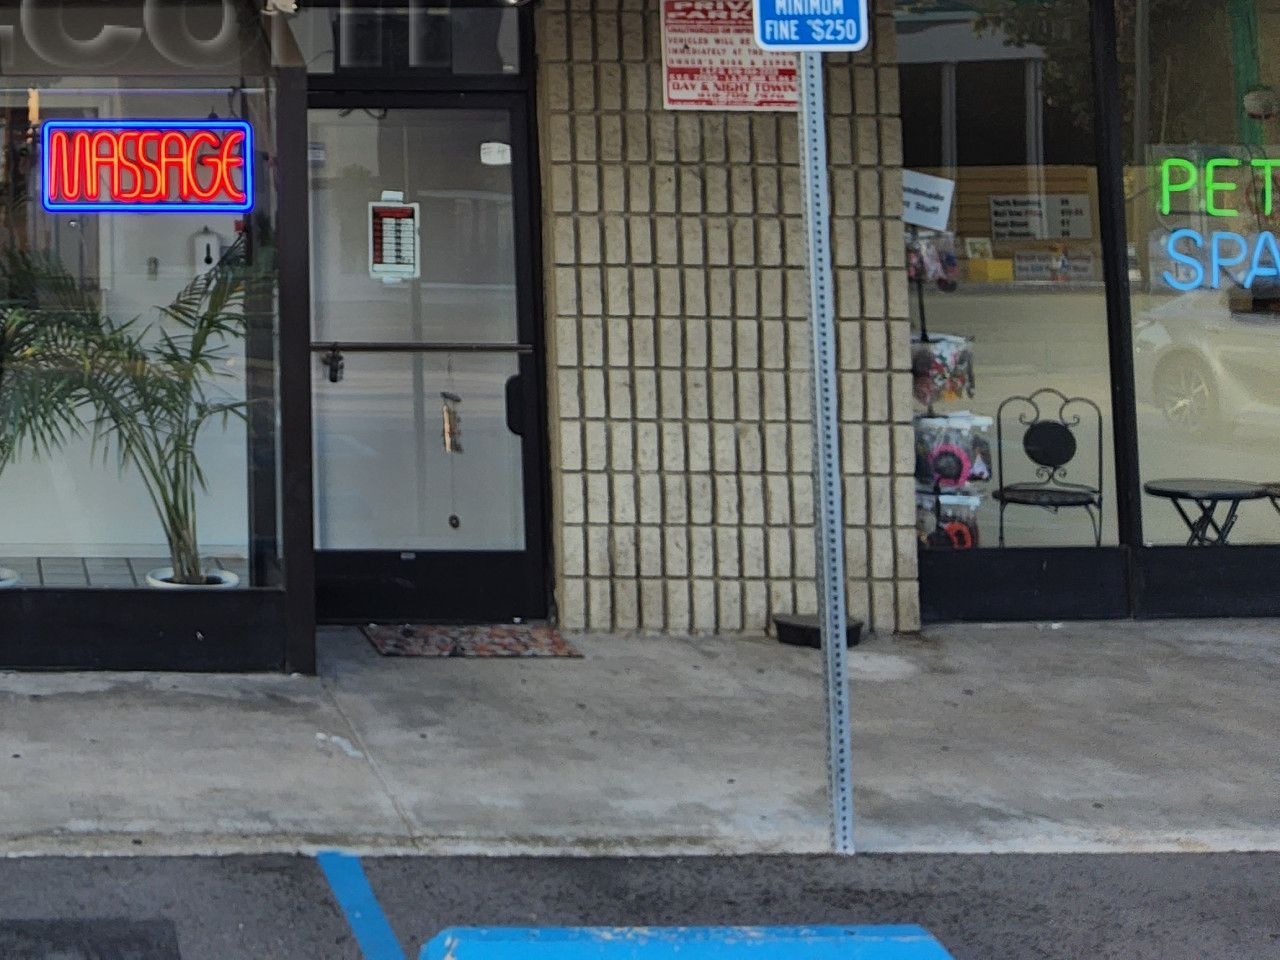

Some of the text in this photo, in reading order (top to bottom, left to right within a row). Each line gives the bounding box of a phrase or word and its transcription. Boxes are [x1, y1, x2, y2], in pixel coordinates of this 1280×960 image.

[667, 10, 752, 19] PARK
[673, 0, 752, 11] PRIV
[765, 18, 857, 42] FINE $250
[755, 82, 797, 92] TOWIN
[49, 130, 246, 202] MASSAGE
[1161, 158, 1280, 216] PET
[1163, 228, 1280, 290] SPA
